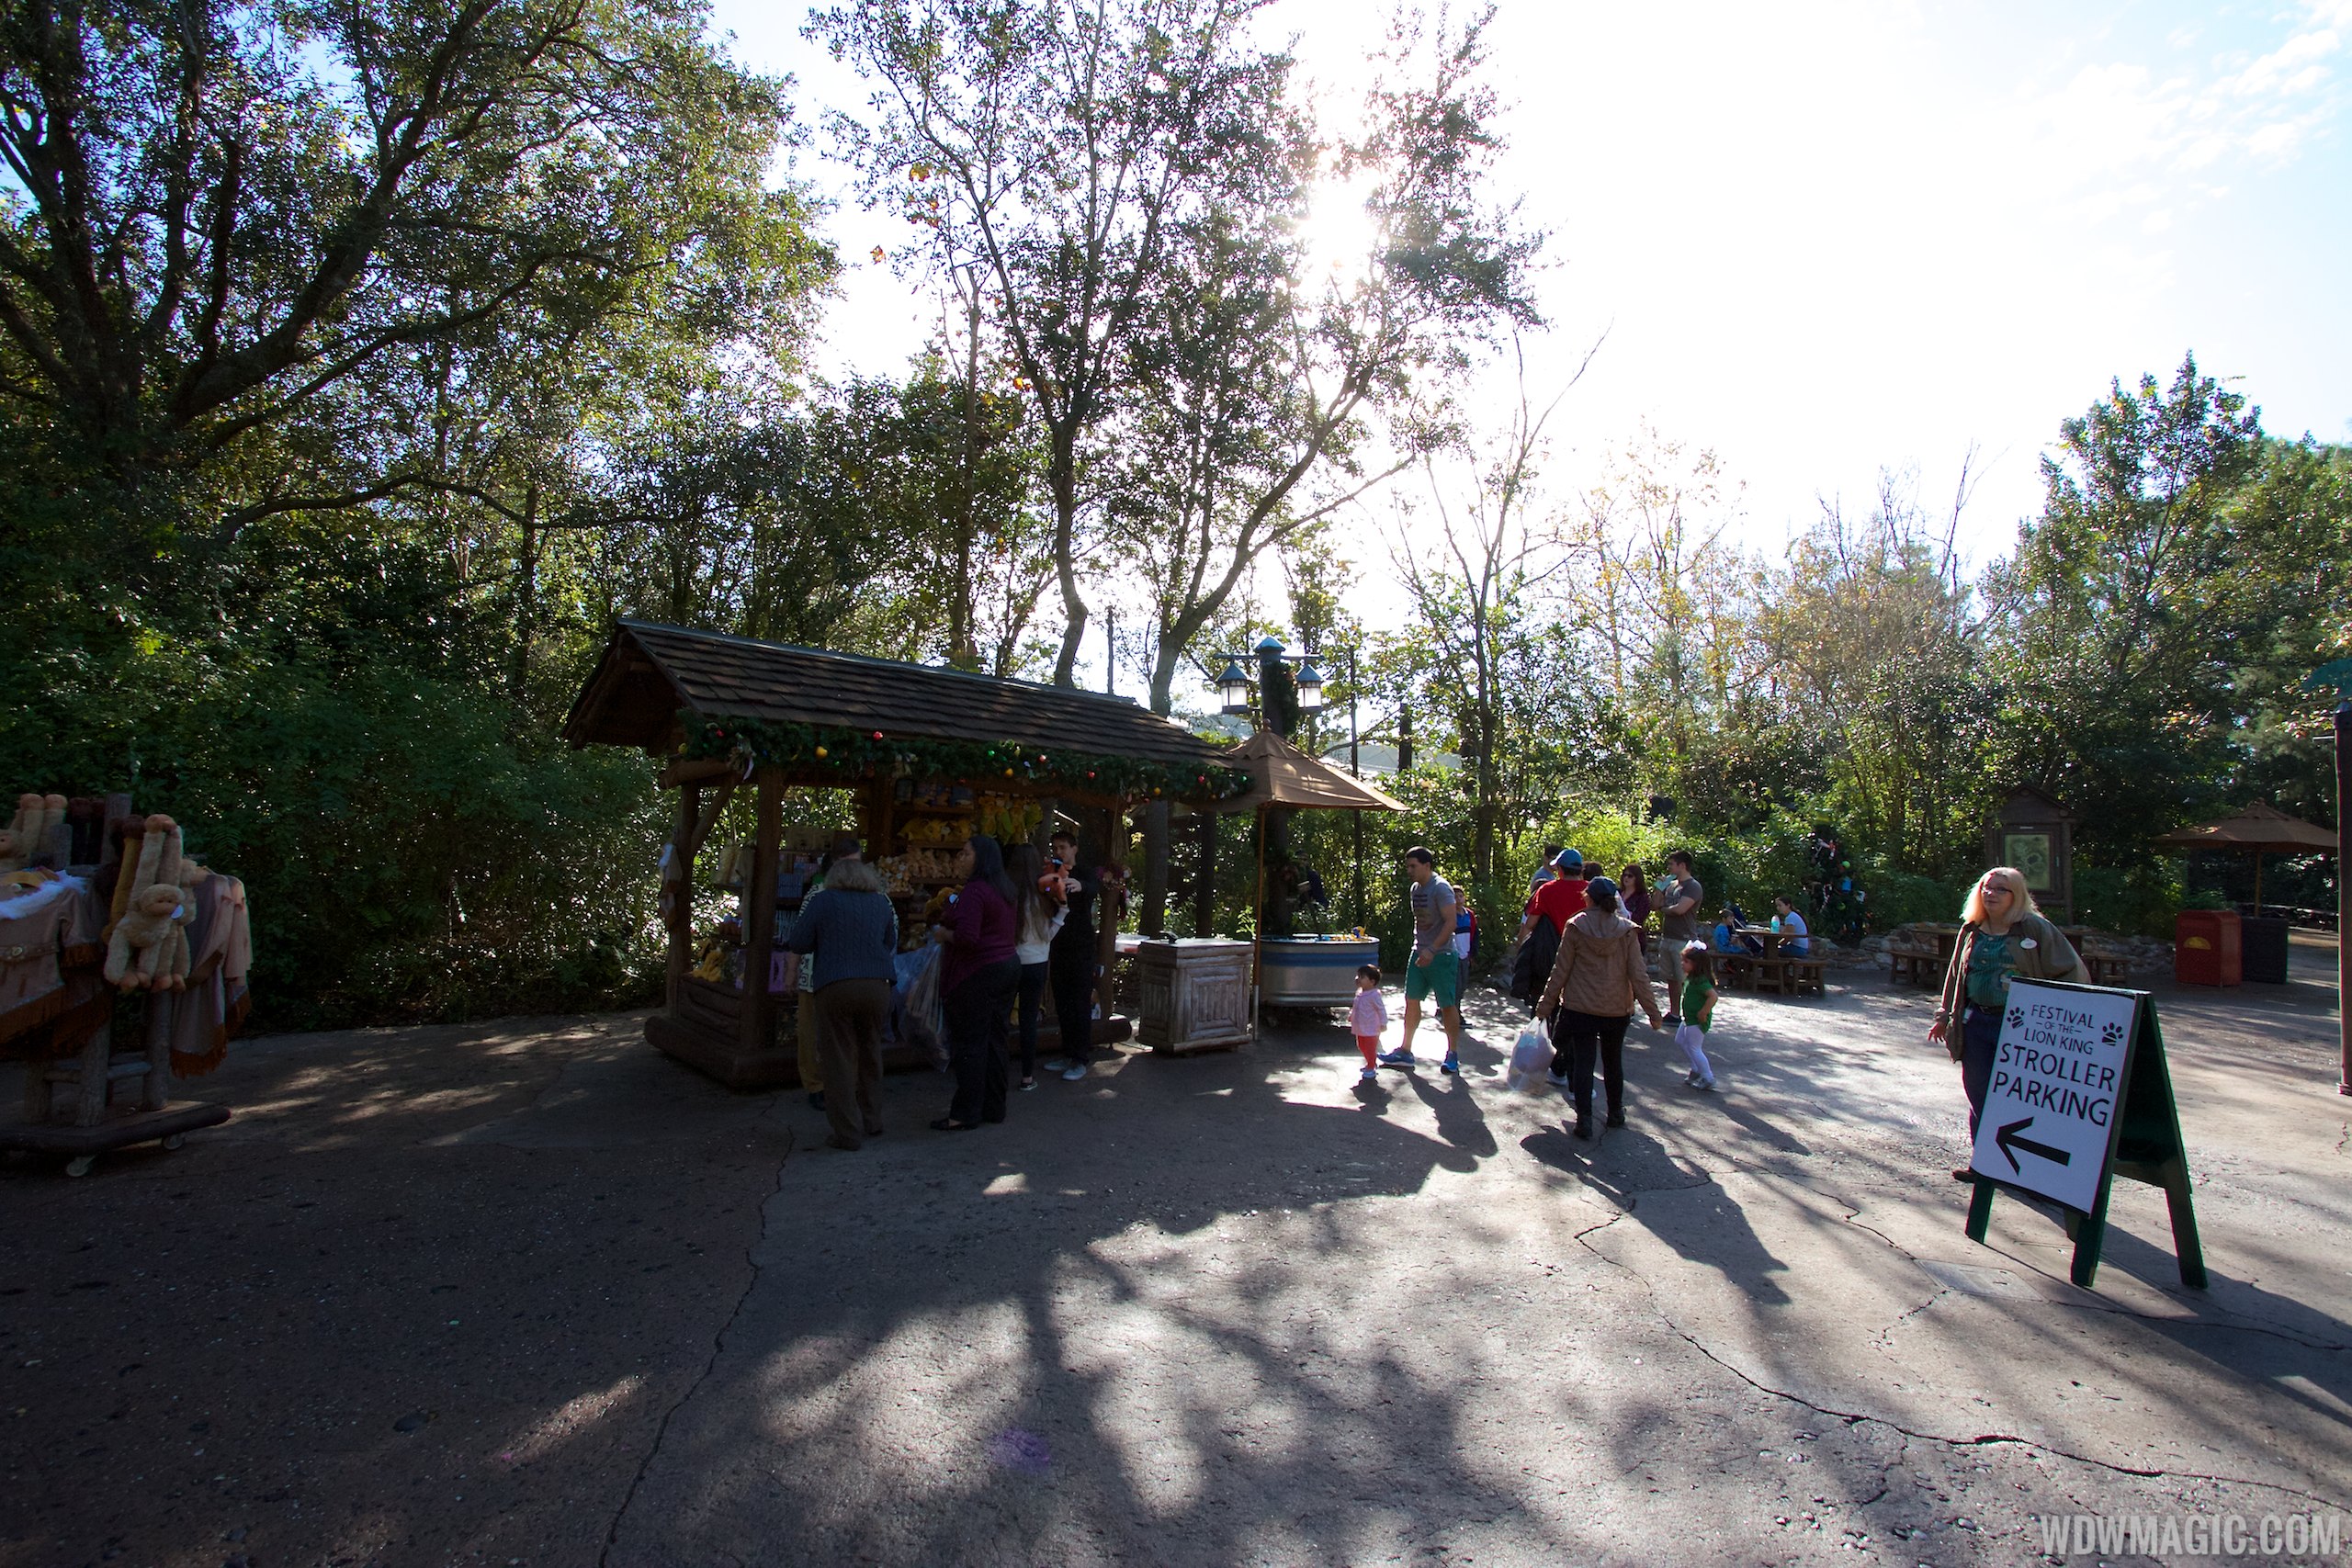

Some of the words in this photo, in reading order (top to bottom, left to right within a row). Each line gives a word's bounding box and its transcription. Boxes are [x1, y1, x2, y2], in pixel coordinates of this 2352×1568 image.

[2030, 1004, 2095, 1029] FESTIVAL
[2024, 1027, 2057, 1047] LION
[2059, 1035, 2094, 1055] KING
[1999, 1043, 2115, 1092] STROLLER
[1993, 1071, 2110, 1127] PARKING
